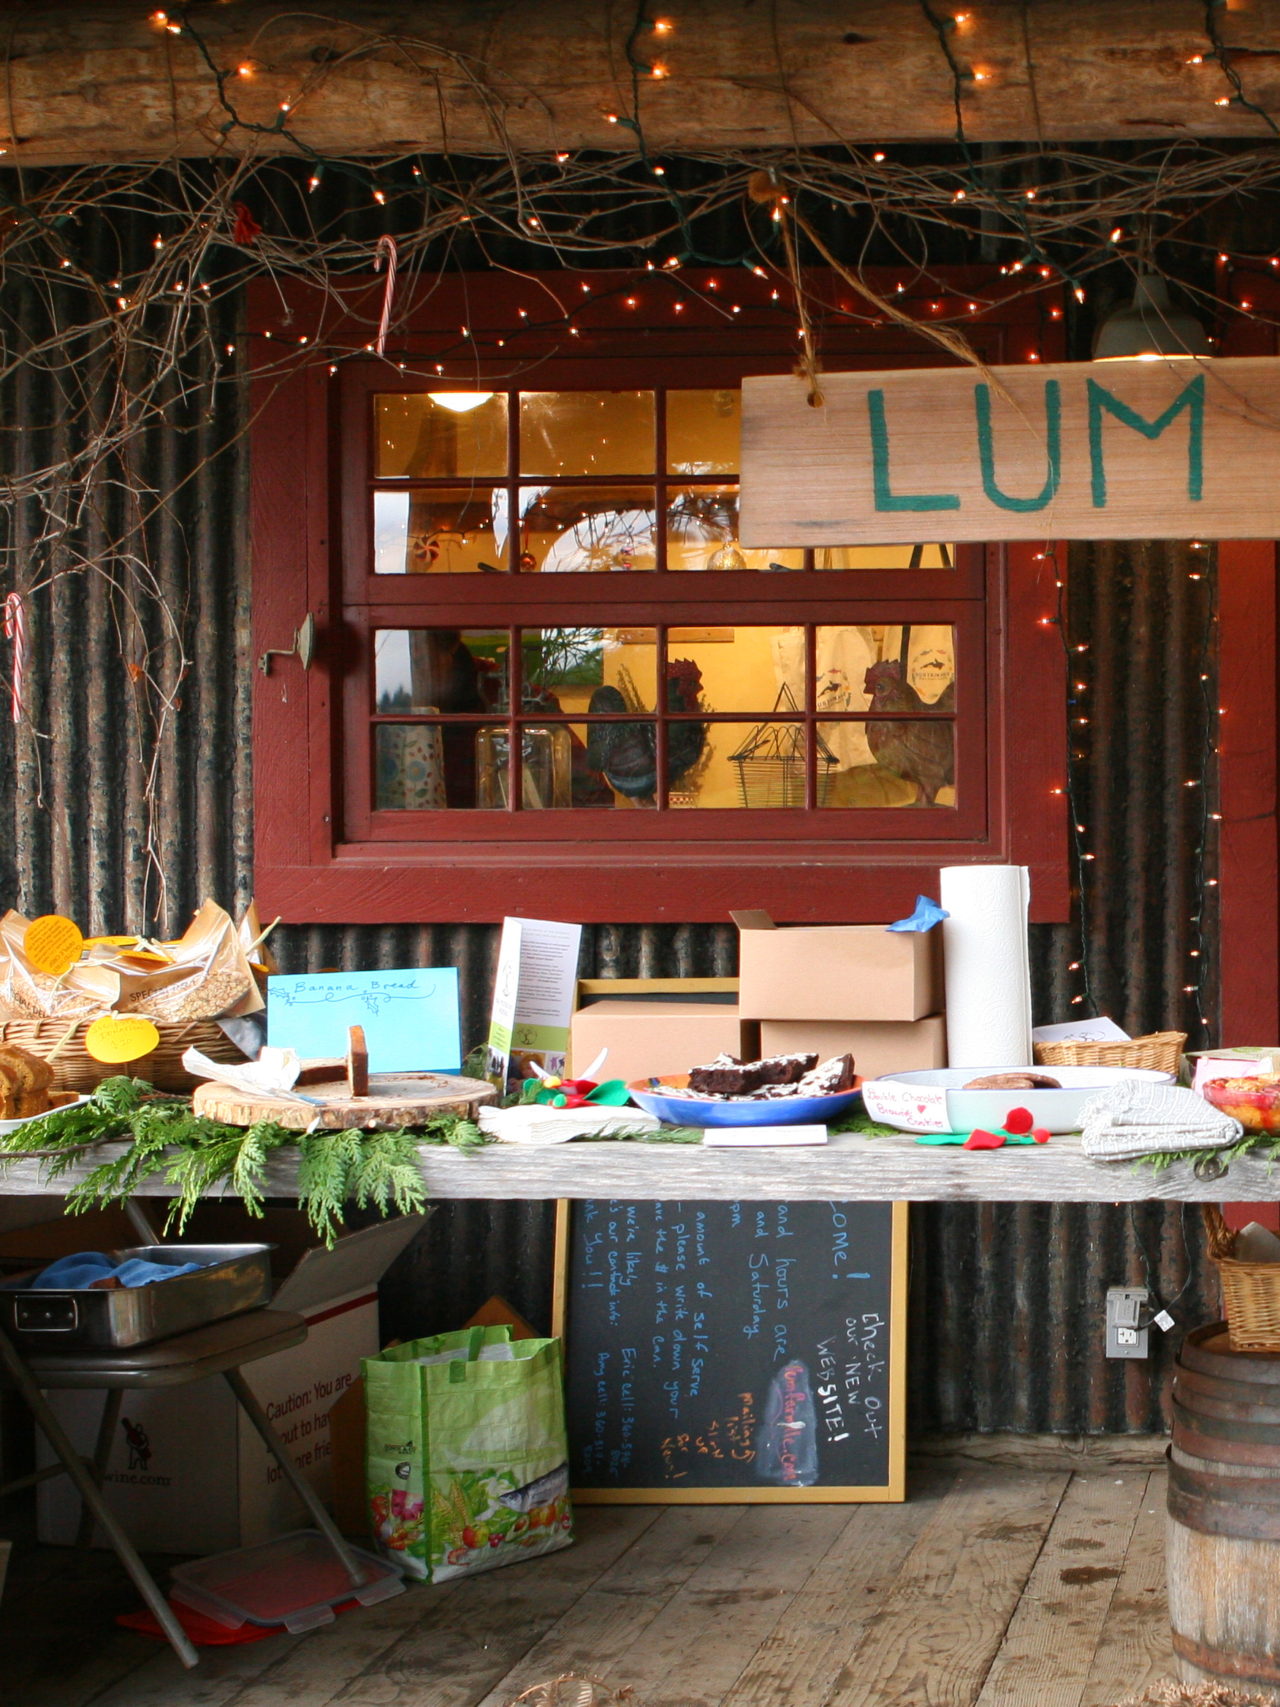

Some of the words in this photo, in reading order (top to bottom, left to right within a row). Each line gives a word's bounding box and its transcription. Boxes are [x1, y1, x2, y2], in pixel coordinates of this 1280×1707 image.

[868, 374, 1206, 514] LUM
[294, 982, 359, 993] Banana
[371, 979, 420, 990] Bread
[626, 1207, 640, 1243] we're
[730, 1202, 742, 1227] pm
[756, 1211, 771, 1237] and
[776, 1202, 793, 1238] and
[609, 1221, 618, 1243] our
[655, 1229, 666, 1254] the
[670, 1224, 688, 1271] please
[696, 1212, 710, 1266] amount
[620, 1252, 641, 1286] likely
[776, 1259, 796, 1310] hours
[655, 1282, 666, 1295] in
[673, 1286, 688, 1320] write
[697, 1283, 712, 1298] of
[746, 1254, 769, 1338] Saturday
[655, 1301, 668, 1324] the
[693, 1313, 710, 1351] self
[773, 1325, 787, 1361] are
[846, 1318, 857, 1345] our
[621, 1348, 636, 1377] Eric
[671, 1330, 687, 1370] down
[266, 1391, 312, 1422] Caution:
[314, 1382, 333, 1399] You
[335, 1373, 352, 1392] are
[663, 1381, 681, 1418] your
[301, 1420, 312, 1437] to
